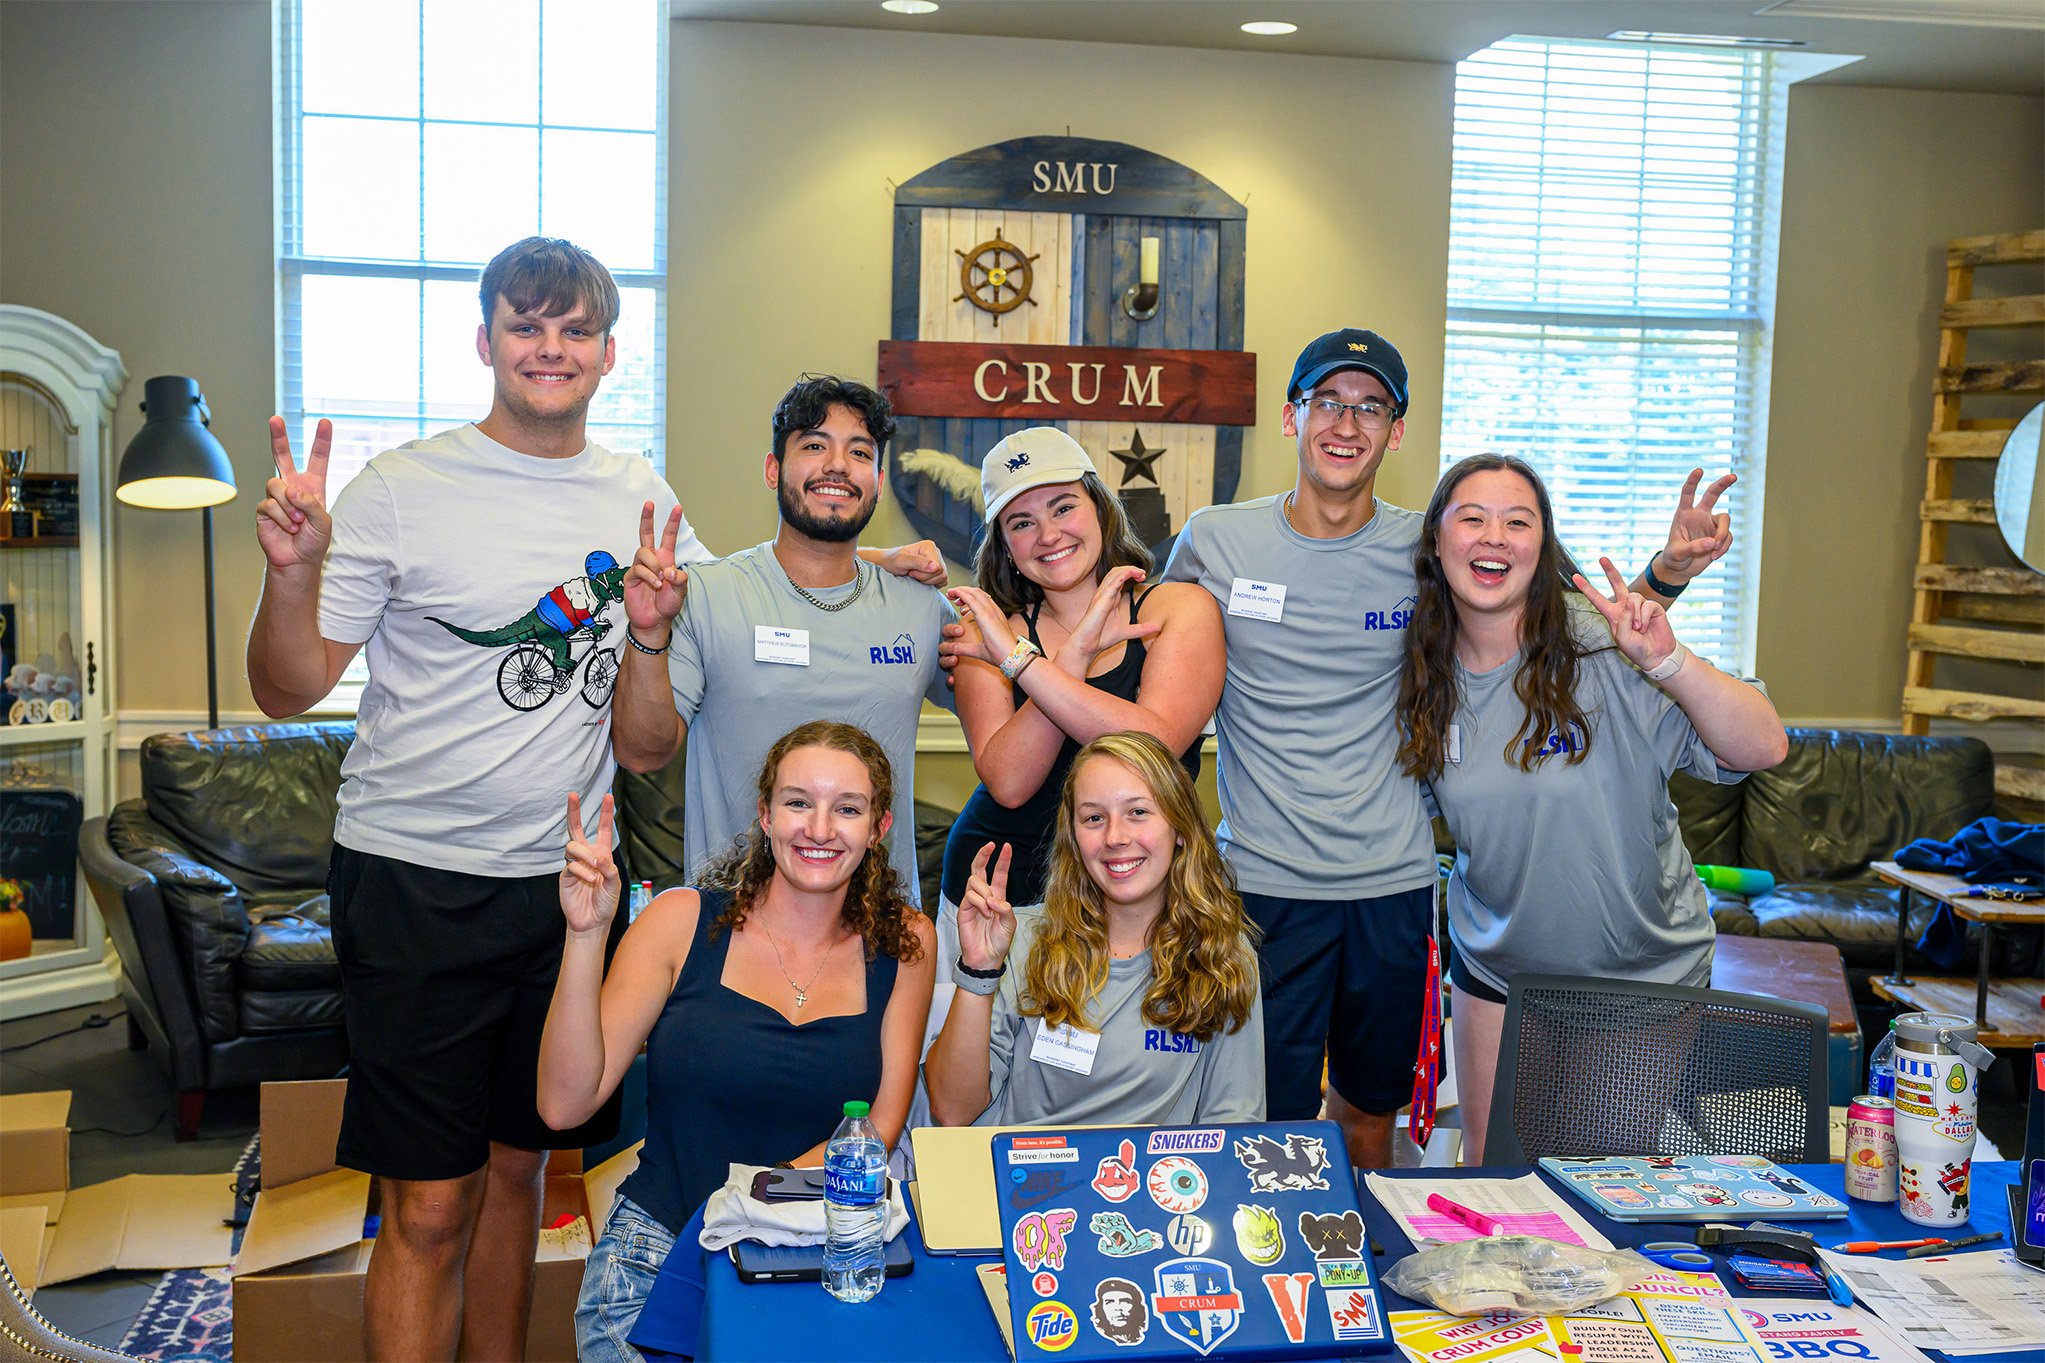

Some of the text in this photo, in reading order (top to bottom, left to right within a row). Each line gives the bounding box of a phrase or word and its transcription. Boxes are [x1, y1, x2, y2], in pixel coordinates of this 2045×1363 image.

[1032, 160, 1118, 195] SMU
[973, 359, 1165, 408] CRUM
[1234, 592, 1281, 604] ANDREW HORTON
[870, 646, 913, 664] RLSH
[1036, 1034, 1054, 1044] EDEN
[1846, 1121, 1894, 1144] WATERLOO
[1945, 1125, 1974, 1134] DALLAS
[1152, 1132, 1220, 1150] SNICKERS
[1012, 1152, 1038, 1160] Strive
[1038, 1152, 1049, 1161] for
[826, 1174, 863, 1192] DASANI
[1020, 1172, 1064, 1192] NIKE
[1174, 1214, 1205, 1256] hp
[1180, 1298, 1216, 1308] CRUM
[1265, 1274, 1314, 1340] V
[1334, 1292, 1368, 1327] SMU
[1772, 1312, 1832, 1322] SMU
[1031, 1312, 1074, 1343] Tide
[1438, 1323, 1484, 1338] WHY
[1432, 1340, 1492, 1360] CRUM
[1676, 1346, 1750, 1356] QUESTIONS?
[1764, 1340, 1880, 1360] BBQ
